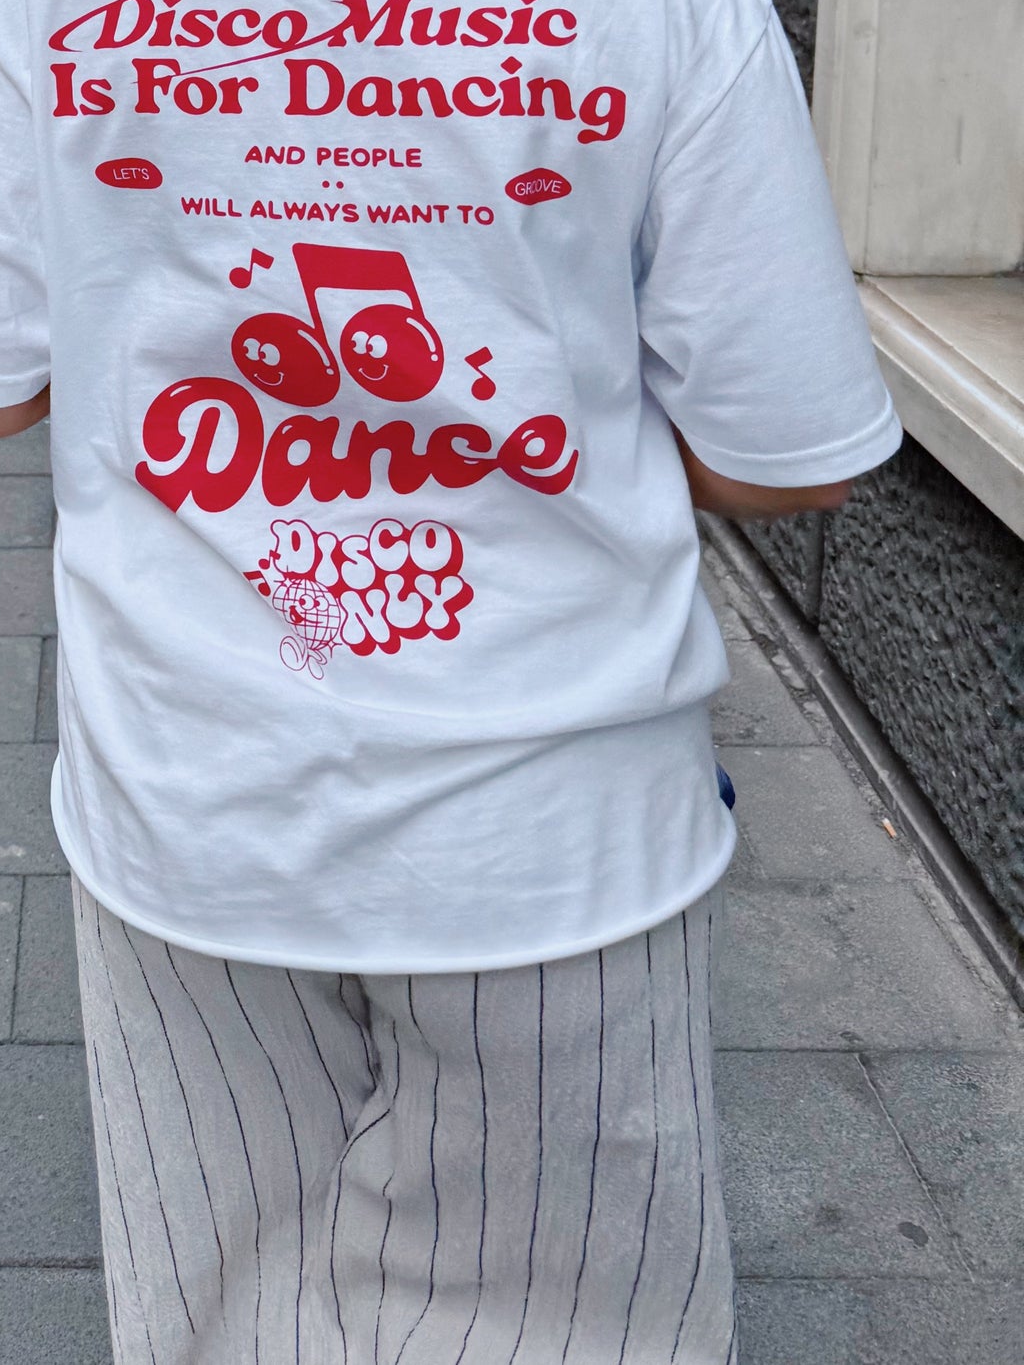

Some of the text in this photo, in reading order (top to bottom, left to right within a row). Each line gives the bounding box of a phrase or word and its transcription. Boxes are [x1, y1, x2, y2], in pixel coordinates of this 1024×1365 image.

[49, 56, 627, 145] Is For Dancing
[112, 167, 150, 180] LET'S
[244, 145, 422, 168] AND PEOPLE
[180, 197, 495, 226] WILL ALWAYS WANT TO
[134, 376, 579, 514] Dance
[270, 518, 464, 590] DISCO
